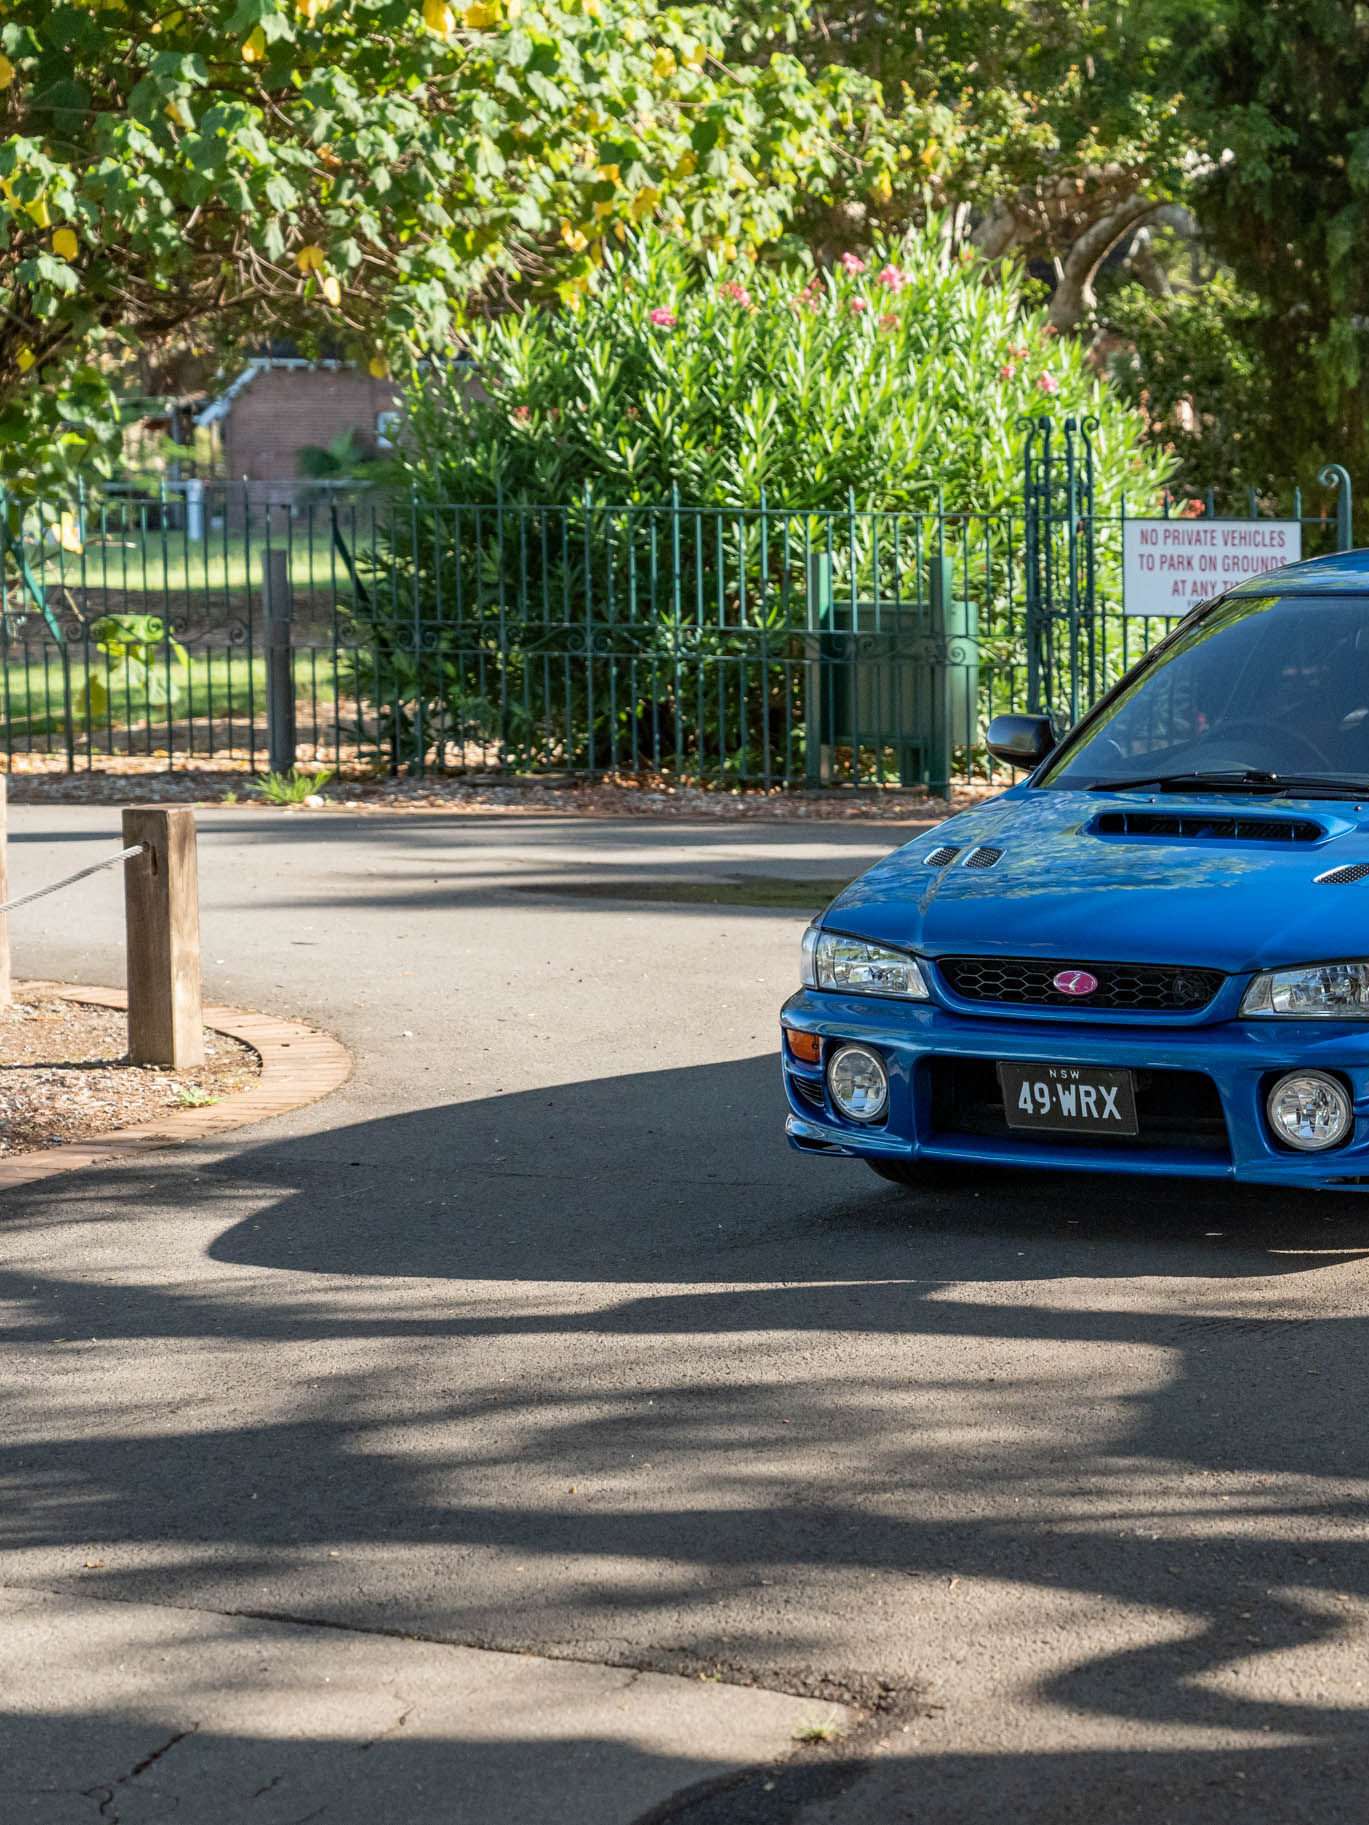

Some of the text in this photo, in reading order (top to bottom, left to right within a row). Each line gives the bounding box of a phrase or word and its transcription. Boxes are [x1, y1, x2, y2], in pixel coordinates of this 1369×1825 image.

[1140, 528, 1286, 548] NO PRIVATE VEHICLES
[1138, 553, 1155, 571] TO
[1159, 554, 1194, 571] PARK
[1200, 554, 1217, 572] ON
[1172, 579, 1186, 596] AT
[1191, 580, 1216, 597] ANY
[1049, 1069, 1080, 1079] NSW
